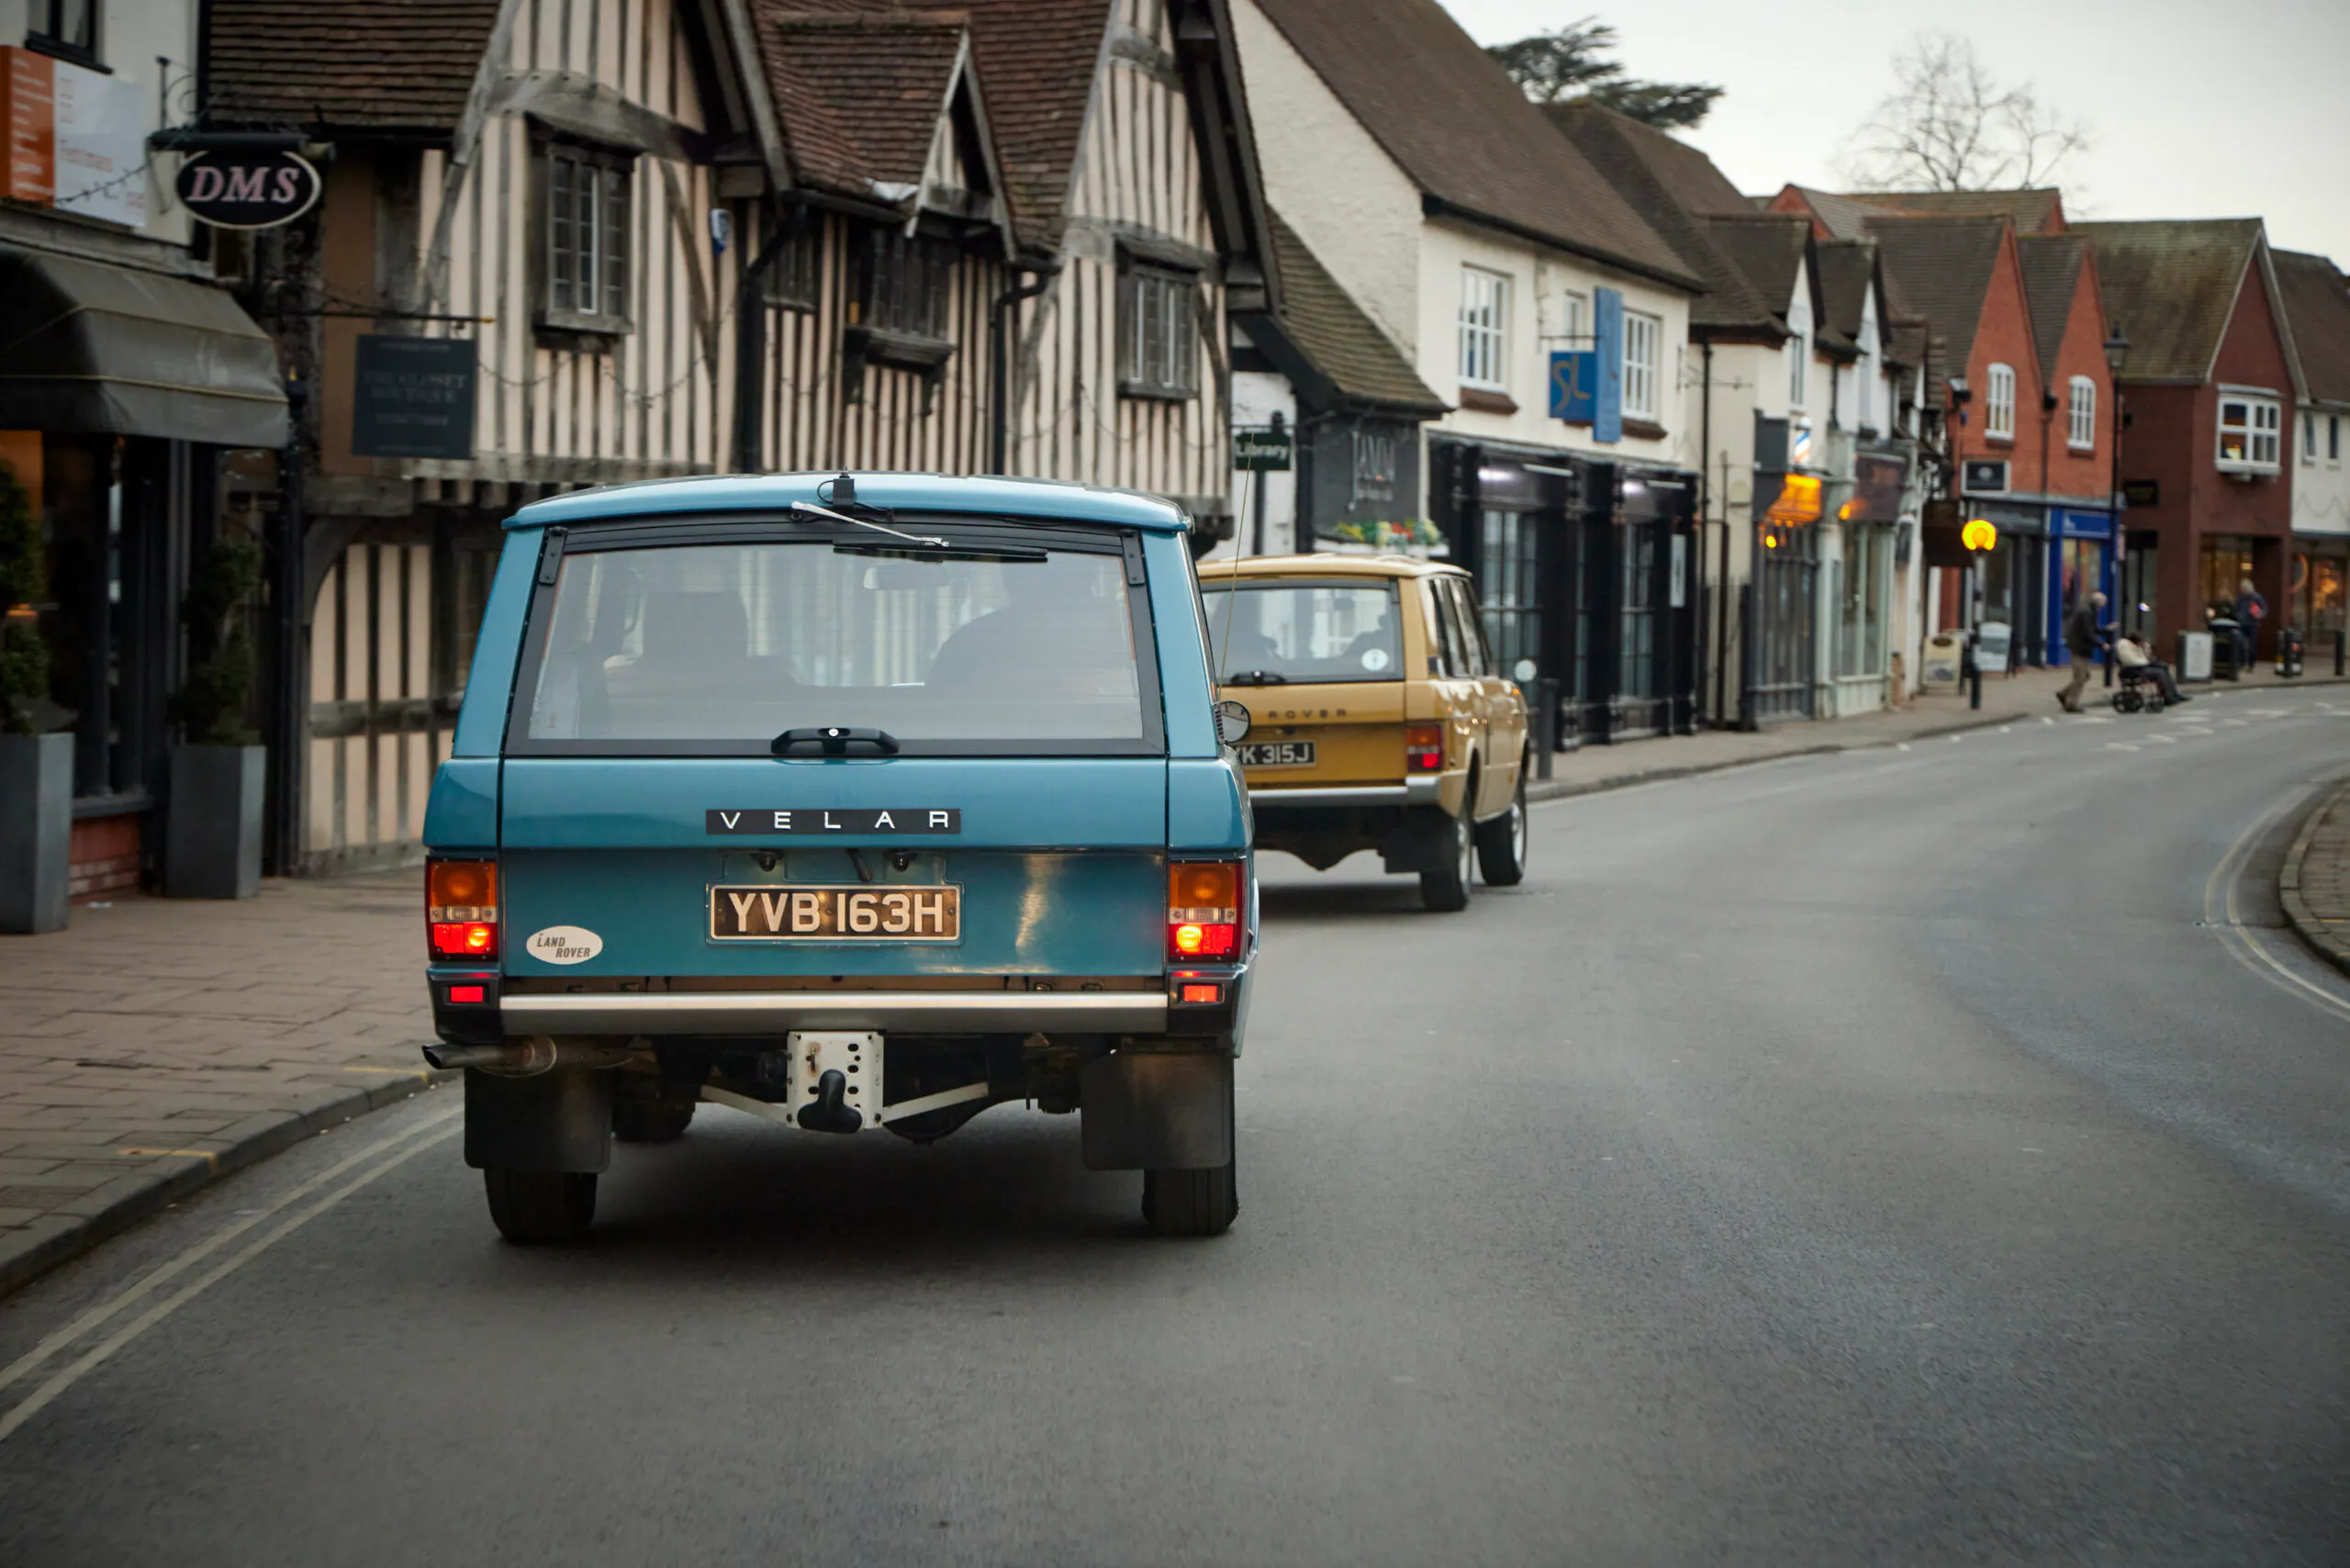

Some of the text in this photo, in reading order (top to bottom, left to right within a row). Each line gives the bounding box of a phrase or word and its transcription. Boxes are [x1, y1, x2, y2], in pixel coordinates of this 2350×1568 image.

[186, 166, 300, 204] DMS
[1236, 442, 1288, 461] Library
[1268, 709, 1347, 720] ROVER
[1261, 744, 1310, 764] 315J
[720, 811, 949, 830] VELAR
[728, 892, 944, 934] YVB 163H
[536, 936, 566, 947] LAND
[555, 947, 591, 958] ROVER
